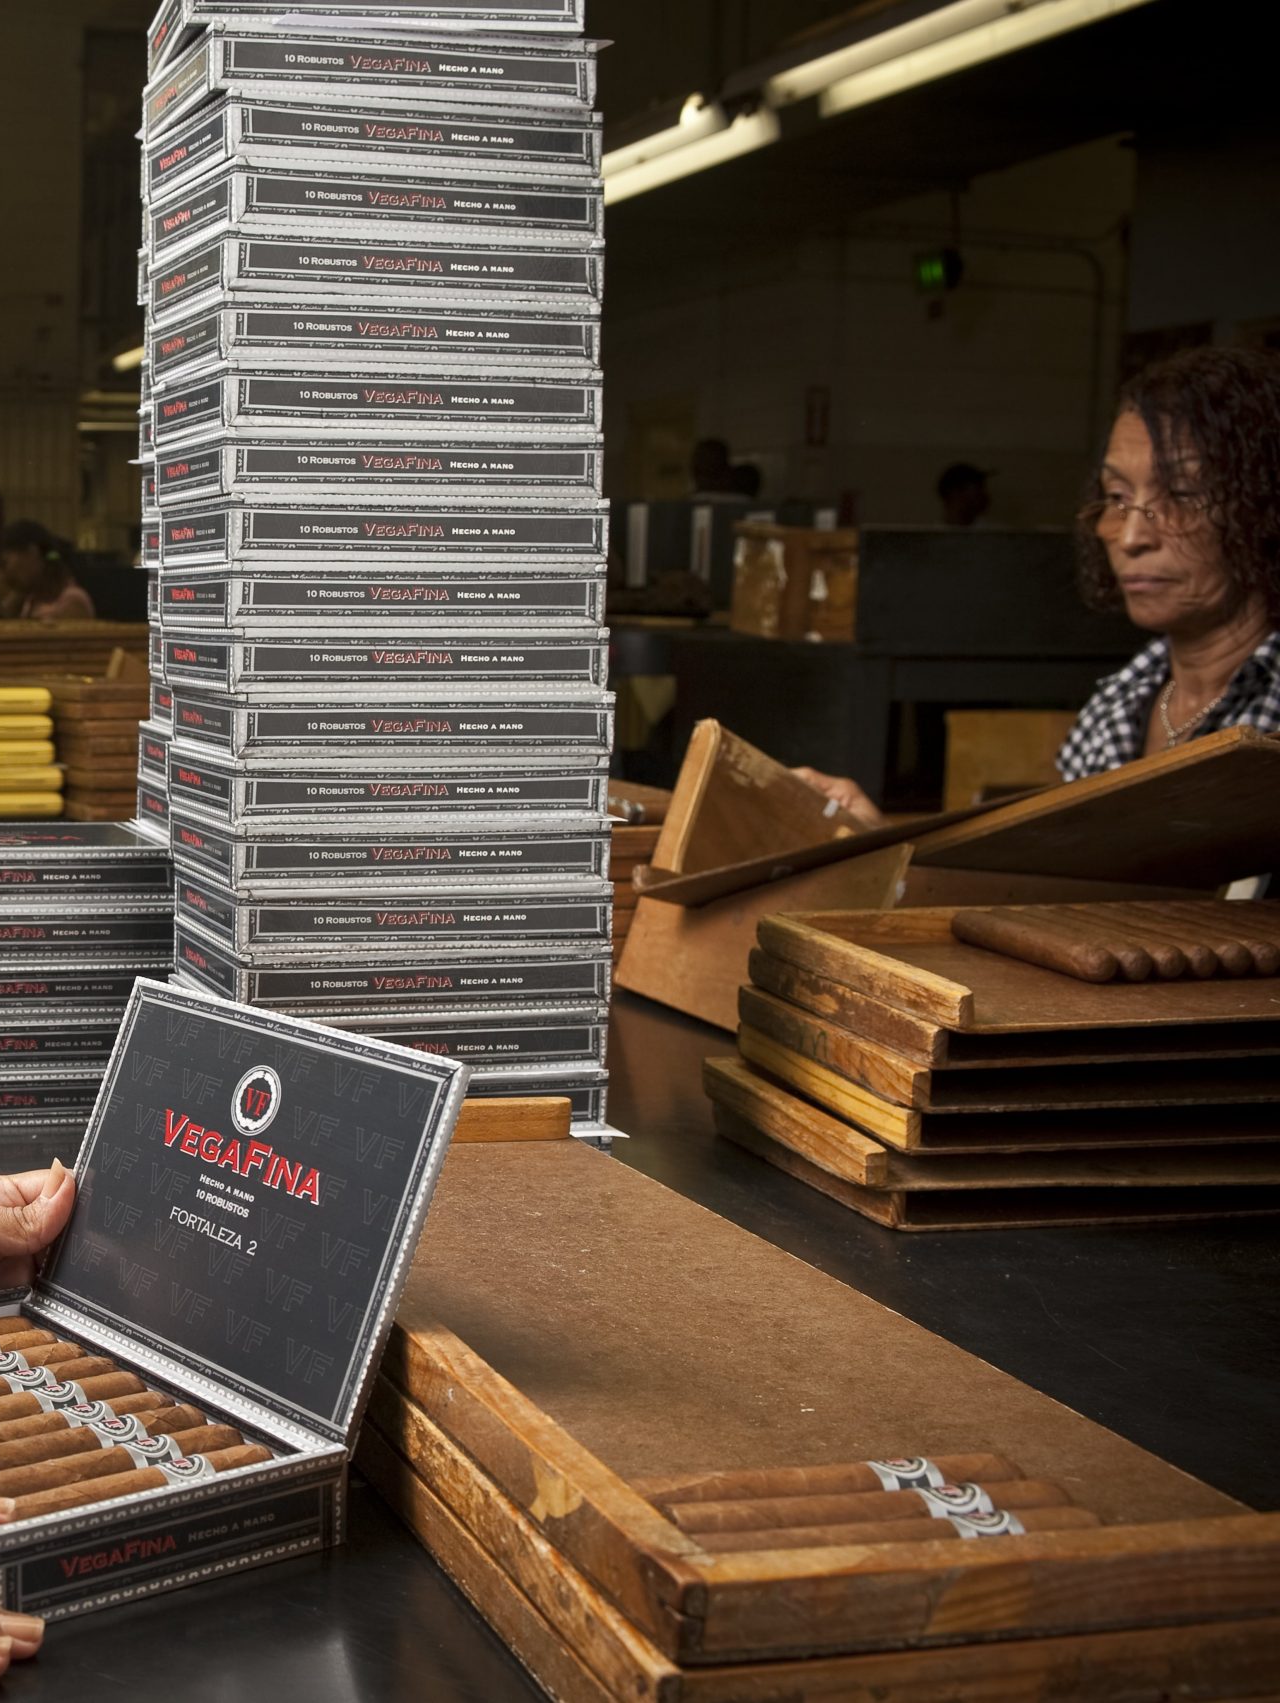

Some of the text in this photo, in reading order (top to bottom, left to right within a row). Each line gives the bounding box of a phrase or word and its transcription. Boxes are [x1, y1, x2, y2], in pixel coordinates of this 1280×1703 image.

[284, 54, 296, 62] 10
[298, 54, 344, 66] ROBUSTOS
[350, 54, 432, 72] VEGAFINA
[438, 64, 468, 72] HECHO
[480, 66, 504, 74] MANO
[300, 122, 312, 130] 10
[314, 122, 360, 134] ROBUSTOS
[365, 122, 444, 141] VEGAFINA
[450, 132, 480, 142] HECHO
[490, 136, 514, 144] MANO
[304, 190, 516, 210] 10 ROBUSTOS VEGAFINA HECHO A MANO
[298, 256, 310, 264] 10
[310, 256, 358, 266] ROBUSTOS
[362, 255, 443, 273] VEGAFINA
[450, 264, 480, 272] HECHO
[292, 322, 304, 330] 10
[306, 322, 352, 332] ROBUSTOS
[357, 321, 438, 338] VEGAFINA
[446, 328, 476, 338] HECHO
[300, 390, 310, 398] 10
[312, 390, 358, 400] ROBUSTOS
[363, 389, 444, 405] VEGAFINA
[450, 396, 480, 404] HECHO
[490, 398, 514, 406] MANO
[296, 454, 514, 470] 10 ROBUSTOS VEGAFINA HECHO A MANO
[300, 522, 516, 537] 10 ROBUSTOS VEGAFINA HECHO A MANO
[306, 590, 318, 598] 10
[318, 590, 366, 598] ROBUSTOS
[369, 586, 450, 601] VEGAFINA
[496, 592, 520, 600] MANO
[310, 654, 320, 662] 10
[322, 654, 368, 662] ROBUSTOS
[373, 650, 453, 664] VEGAFINA
[460, 654, 490, 662] HECHO
[306, 722, 318, 730] 10
[320, 722, 366, 730] ROBUSTOS
[371, 718, 452, 732] VEGAFINA
[458, 722, 488, 730] HECHO
[306, 782, 520, 797] 10 ROBUSTOS VEGAFINA HECHO A MANO
[308, 852, 320, 860] 10
[320, 852, 368, 860] ROBUSTOS
[371, 846, 452, 861] VEGAFINA
[458, 850, 488, 858] HECHO
[314, 916, 324, 924] 10
[326, 916, 372, 924] ROBUSTOS
[376, 910, 457, 925] VEGAFINA
[462, 914, 492, 922] HECHO
[310, 980, 322, 988] 10
[322, 980, 368, 988] ROBUSTOS
[373, 974, 453, 989] VEGAFINA
[460, 978, 490, 986] HECHO
[457, 1044, 486, 1052] HECHO
[246, 1087, 271, 1117] VF
[164, 1109, 320, 1205] VEGAFINA
[199, 1174, 225, 1190] HECHO
[233, 1189, 255, 1203] MANO
[196, 1188, 250, 1218] 10 ROBUSTOS
[169, 1206, 258, 1256] FORTALEZA 2
[59, 1535, 177, 1577] VEGAFINA
[231, 1522, 240, 1531] A
